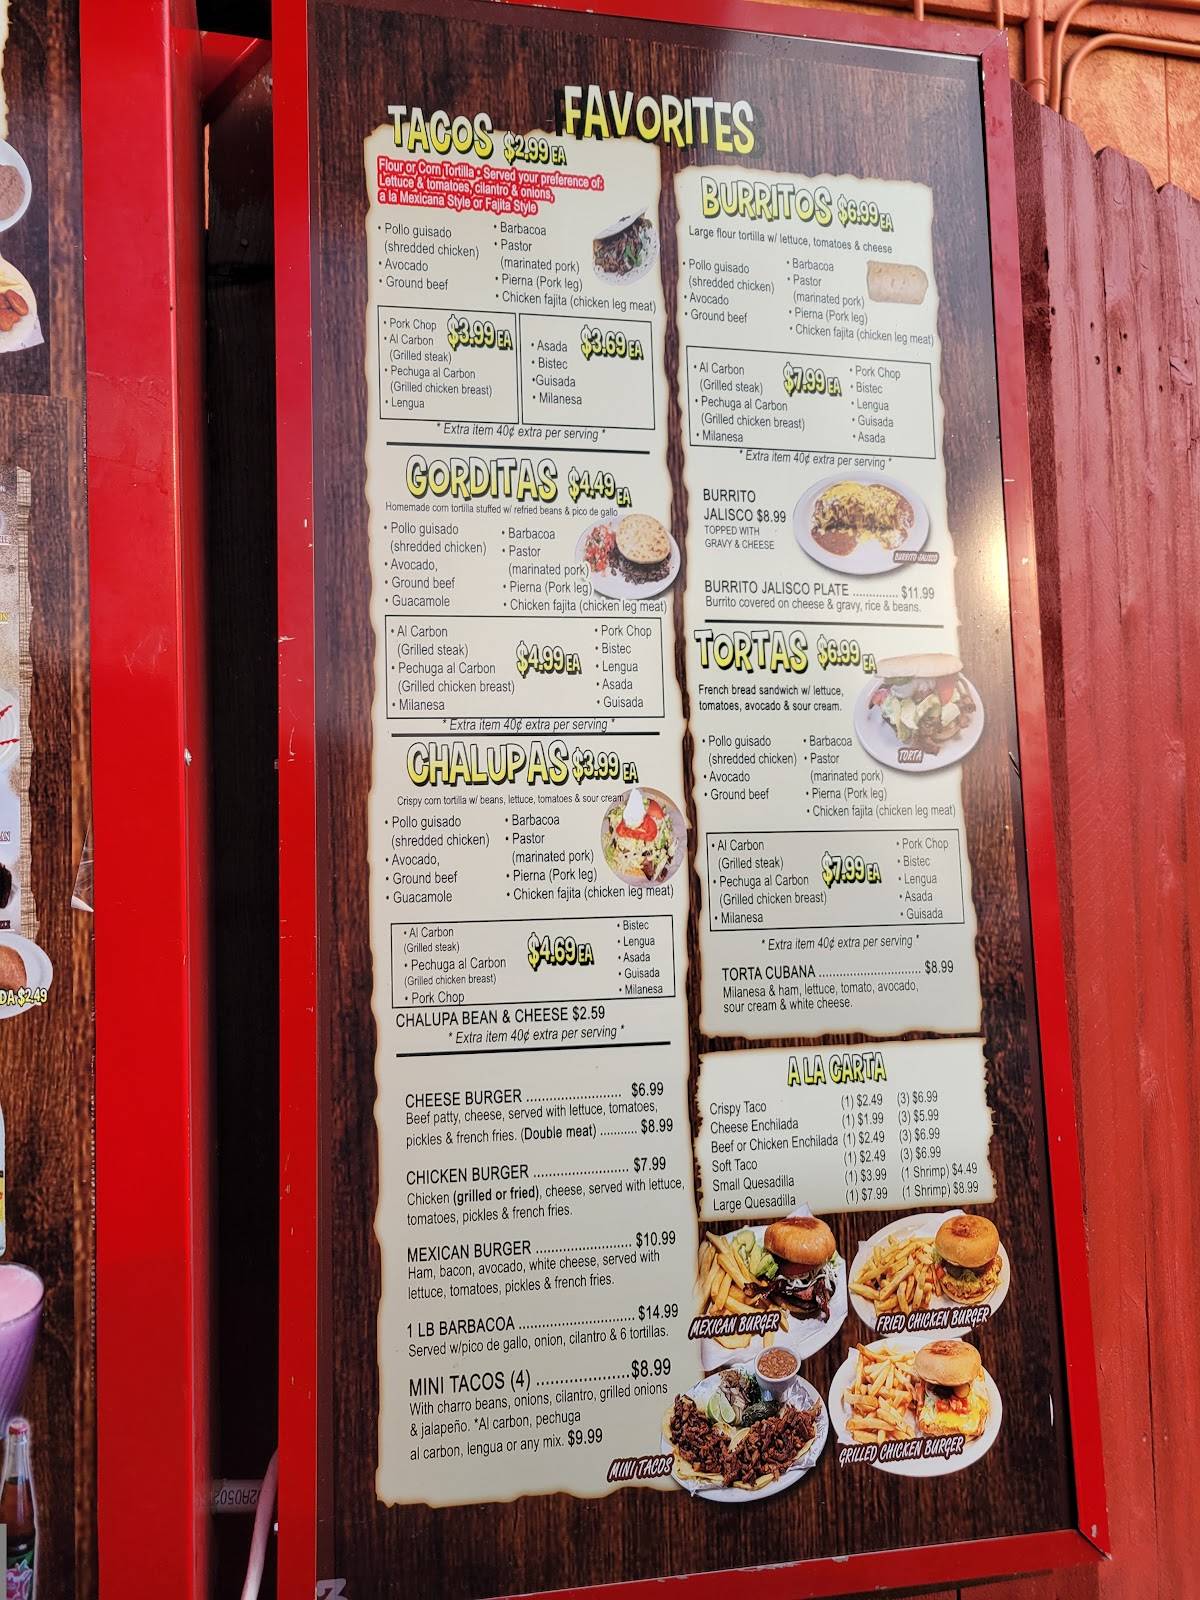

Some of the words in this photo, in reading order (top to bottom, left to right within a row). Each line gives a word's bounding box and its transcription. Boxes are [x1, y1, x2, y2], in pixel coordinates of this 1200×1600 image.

[564, 85, 754, 154] FAVORITES
[388, 105, 494, 159] TACOS
[503, 131, 550, 165] $2.99
[552, 146, 567, 165] EA
[379, 158, 404, 173] Flour
[406, 163, 417, 175] or
[418, 162, 441, 176] Corn
[443, 164, 474, 178] Tortilla
[483, 168, 515, 181] Served
[519, 172, 538, 185] your
[541, 174, 588, 189] preference
[591, 176, 603, 190] of:
[379, 175, 414, 188] Lettuce
[417, 178, 424, 189] &
[427, 179, 472, 194] tomatoes,
[475, 182, 508, 195] cilantro
[512, 185, 518, 196] &
[521, 185, 554, 201] onions,
[379, 193, 386, 201] a
[388, 191, 397, 202] la
[400, 190, 444, 206] Mexicana
[447, 194, 471, 210] Style
[473, 198, 482, 208] or
[485, 199, 512, 214] Fajita
[514, 201, 537, 215] Style
[701, 176, 832, 227] BURRITOS
[837, 193, 880, 227] $6.99
[880, 213, 894, 232] EA
[384, 222, 410, 236] Pollo
[412, 226, 452, 238] guisado
[500, 222, 546, 236] Barbacoa
[688, 226, 714, 240] Large
[716, 228, 736, 240] flour
[738, 230, 764, 242] tortilla
[768, 232, 778, 242] w/
[780, 234, 810, 248] lettuce,
[814, 236, 852, 250] tomatoes
[854, 240, 860, 250] &
[862, 242, 892, 254] cheese
[384, 240, 434, 254] (shredded
[438, 244, 480, 260] chicken)
[500, 238, 532, 252] Pastor
[384, 258, 428, 272] Avocado
[500, 256, 552, 270] (marinated
[556, 260, 580, 276] pork)
[386, 276, 424, 288] Ground
[426, 278, 448, 290] beef
[502, 272, 534, 286] Pierna
[536, 276, 562, 290] (Pork
[564, 278, 582, 292] leg)
[502, 290, 542, 304] Chicken
[544, 292, 568, 308] fajita
[570, 294, 610, 310] (chicken
[612, 298, 626, 312] leg
[630, 302, 656, 314] meat)
[390, 318, 410, 328] Pork
[412, 318, 436, 332] Chop
[447, 314, 495, 351] $3.99
[497, 330, 513, 350] EA
[390, 334, 398, 344] Al
[400, 334, 434, 346] Carbon
[536, 340, 568, 352] Asada
[580, 324, 627, 361] $3.69
[628, 340, 644, 360] EA
[538, 356, 568, 370] Bistec
[536, 374, 576, 388] Guisada
[783, 361, 826, 397] $7.99
[827, 377, 842, 396] EA
[392, 396, 424, 410] Lengua
[540, 392, 582, 404] Milanesa
[406, 454, 558, 502] GORDITAS
[568, 467, 615, 503] $4.49
[616, 489, 632, 507] EA
[702, 488, 756, 504] BURRITO
[704, 508, 754, 522] JALISCO
[756, 508, 786, 524] $8.99
[704, 524, 738, 536] TOPPED
[738, 526, 760, 536] WITH
[704, 538, 732, 548] GRAVY
[734, 540, 740, 548] &
[742, 540, 774, 550] CHEESE
[392, 594, 450, 606] Guacamole
[704, 580, 758, 594] BURRITO
[762, 580, 810, 596] JALISCO
[814, 582, 848, 596] PLATE
[902, 586, 934, 600] $11.99
[516, 640, 565, 678] $4.99
[566, 654, 582, 674] EA
[694, 628, 808, 674] TORTAS
[817, 634, 861, 669] $6.99
[862, 655, 877, 673] EA
[407, 740, 570, 786] CHALUPAS
[572, 747, 620, 784] $3.99
[622, 762, 638, 783] EA
[898, 750, 923, 763] TORTA
[822, 851, 866, 888] $7.99
[866, 863, 882, 883] EA
[527, 932, 577, 972] $4.69
[577, 944, 594, 966] EA
[722, 966, 762, 982] TORTA
[766, 964, 816, 980] CUBANA
[924, 960, 954, 976] $8.99
[17, 987, 47, 1006] $2.49
[396, 1012, 460, 1028] CHALUPA
[462, 1010, 498, 1026] BEAN
[502, 1008, 510, 1024] &
[514, 1006, 568, 1024] CHEESE
[572, 1004, 606, 1022] $2.59
[788, 1056, 801, 1086] A
[803, 1054, 826, 1085] LA
[828, 1051, 887, 1083] CARTA
[406, 1092, 460, 1108] CHEESE
[466, 1088, 522, 1106] BURGER
[632, 1082, 664, 1098] $6.99
[710, 1102, 740, 1118] Crispy
[744, 1100, 766, 1112] Taco
[842, 1094, 854, 1110] (1)
[856, 1094, 882, 1108] $2.49
[896, 1092, 910, 1107] (3)
[912, 1090, 938, 1104] $6.99
[406, 1110, 430, 1124] Beef
[434, 1110, 460, 1126] patty,
[464, 1108, 504, 1122] cheese,
[508, 1104, 542, 1120] served
[546, 1104, 566, 1118] with
[570, 1104, 606, 1116] lettuce,
[608, 1100, 658, 1114] tomatoes,
[406, 1168, 468, 1186] CHICKEN
[472, 1164, 530, 1182] BURGER
[634, 1156, 666, 1174] $7.99
[714, 1198, 742, 1214] Large
[744, 1194, 796, 1208] Quesadilla
[846, 1188, 858, 1204] (1)
[862, 1186, 888, 1202] $7.99
[902, 1186, 910, 1200] (1
[914, 1182, 950, 1198] Shrimp)
[952, 1180, 978, 1196] $8.99
[408, 1244, 470, 1262] MEXICAN
[474, 1240, 532, 1258] BURGER
[636, 1230, 676, 1248] $10.99
[406, 1322, 412, 1338] 1
[418, 1322, 434, 1338] LB
[440, 1316, 516, 1336] BARBACOA
[638, 1304, 678, 1322] $14.99
[691, 1316, 736, 1337] MEXICAN
[737, 1313, 779, 1333] BURGER
[877, 1316, 906, 1332] FRIED
[909, 1312, 950, 1329] CHICKEN
[951, 1308, 989, 1325] BURGER
[410, 1376, 444, 1396] MINI
[448, 1372, 504, 1394] TACOS
[510, 1368, 530, 1392] (4)
[840, 1445, 878, 1463] GRILLED
[880, 1442, 923, 1459] CHICKEN
[925, 1438, 964, 1455] BURGER
[609, 1461, 636, 1480] MINI
[636, 1456, 672, 1475] TACOS
